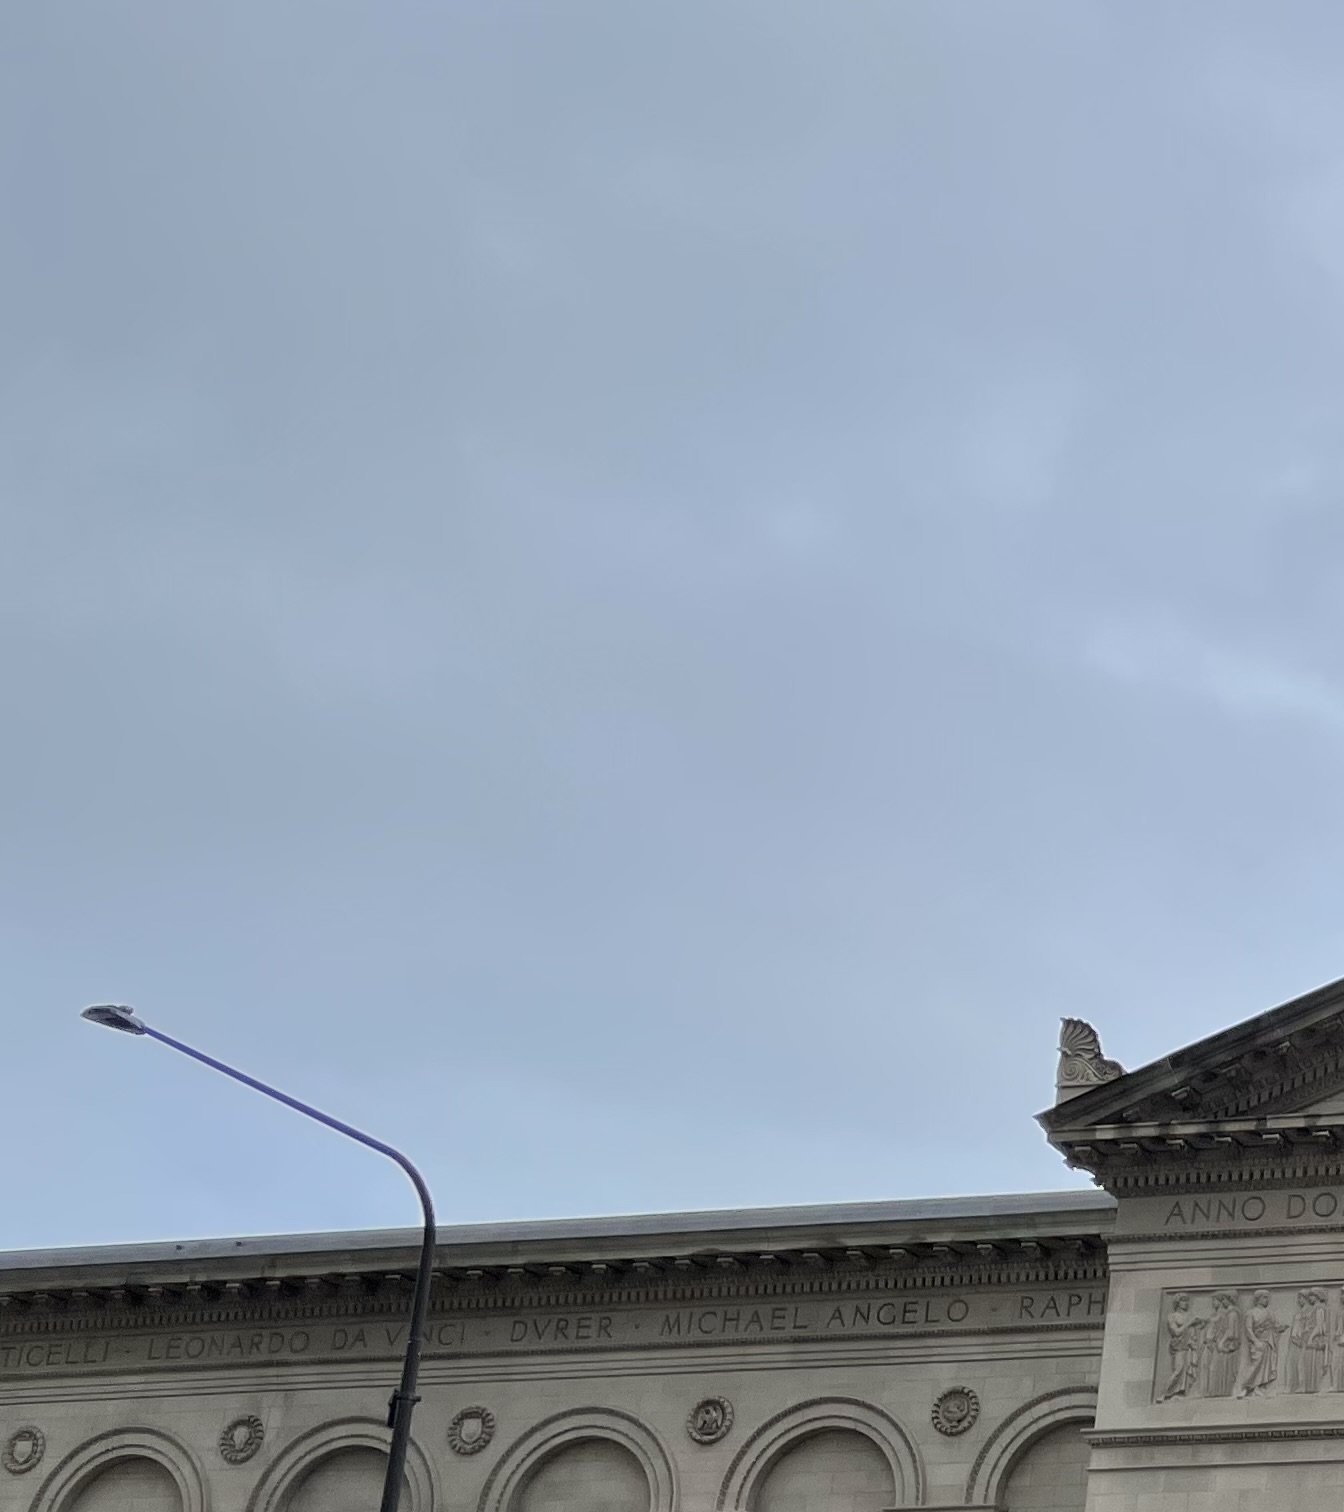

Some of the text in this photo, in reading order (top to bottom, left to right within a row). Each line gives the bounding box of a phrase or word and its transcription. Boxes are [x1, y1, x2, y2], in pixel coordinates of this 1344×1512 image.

[1164, 1195, 1267, 1226] ANNO
[145, 1330, 310, 1361] LEONARDO
[332, 1327, 368, 1351] DA
[385, 1321, 466, 1347] VNCI
[510, 1315, 613, 1343] DVRER
[658, 1307, 809, 1338] MICHAEL
[826, 1299, 971, 1329] ANGELO
